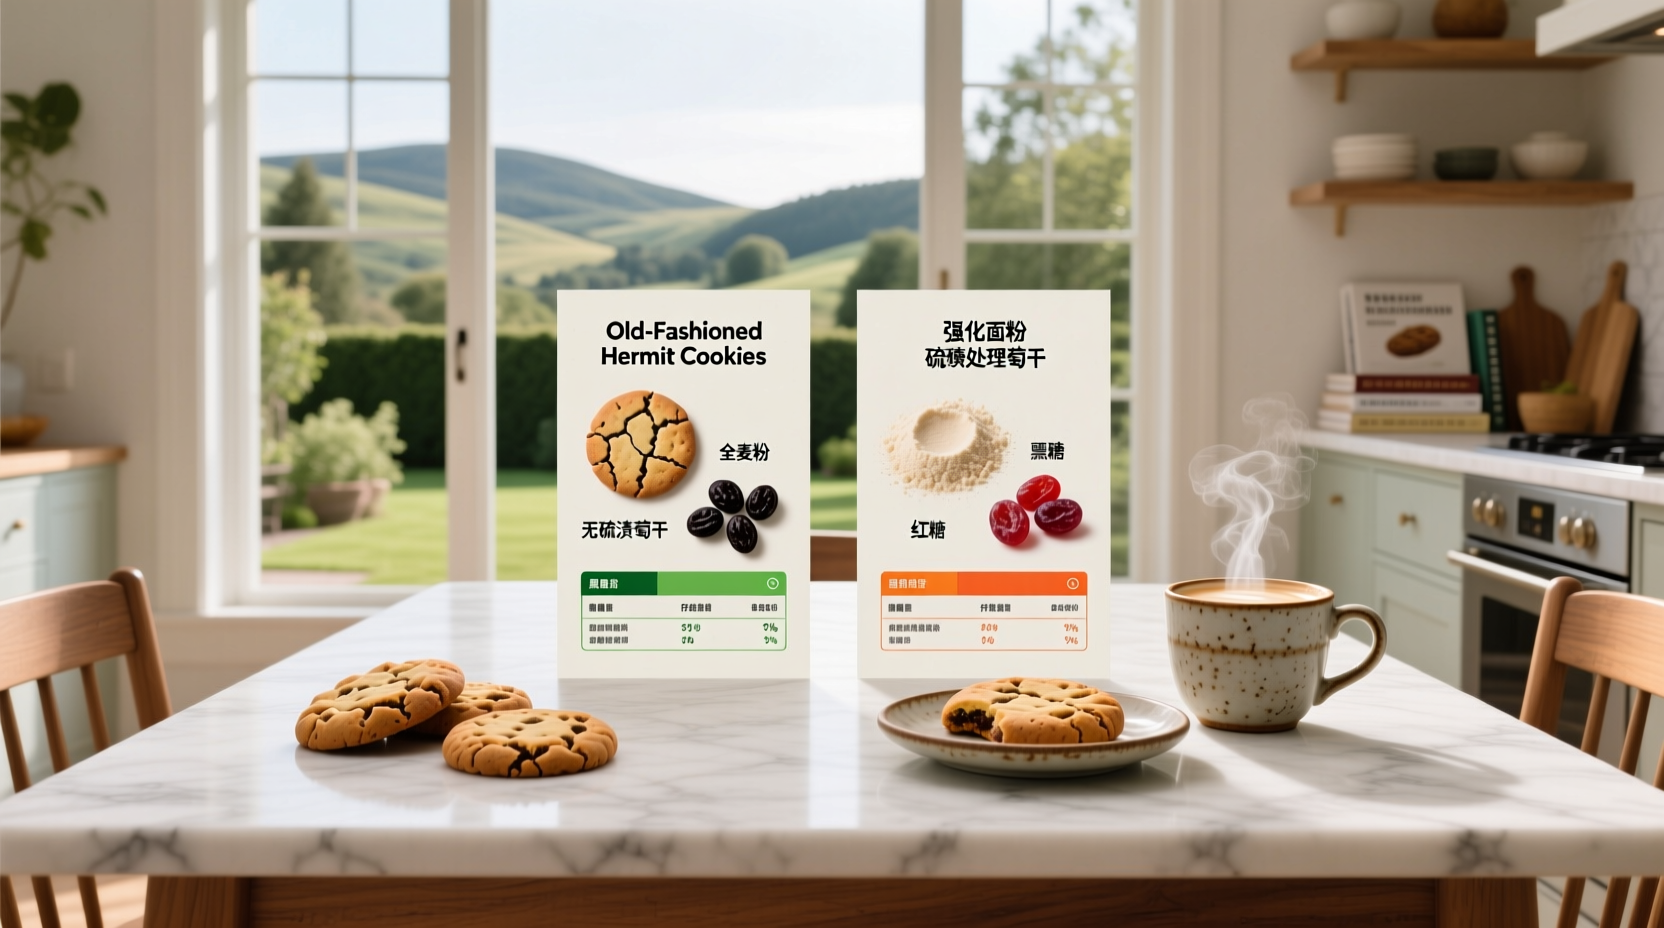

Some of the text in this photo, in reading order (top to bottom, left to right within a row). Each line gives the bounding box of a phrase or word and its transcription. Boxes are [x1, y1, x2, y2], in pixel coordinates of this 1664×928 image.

[606, 320, 763, 341] Old-Fashioned
[943, 319, 1027, 343] 强化面粉
[601, 345, 767, 366] Hermit Cookies
[719, 442, 771, 462] 全麦粉
[910, 519, 946, 540] 红糖
